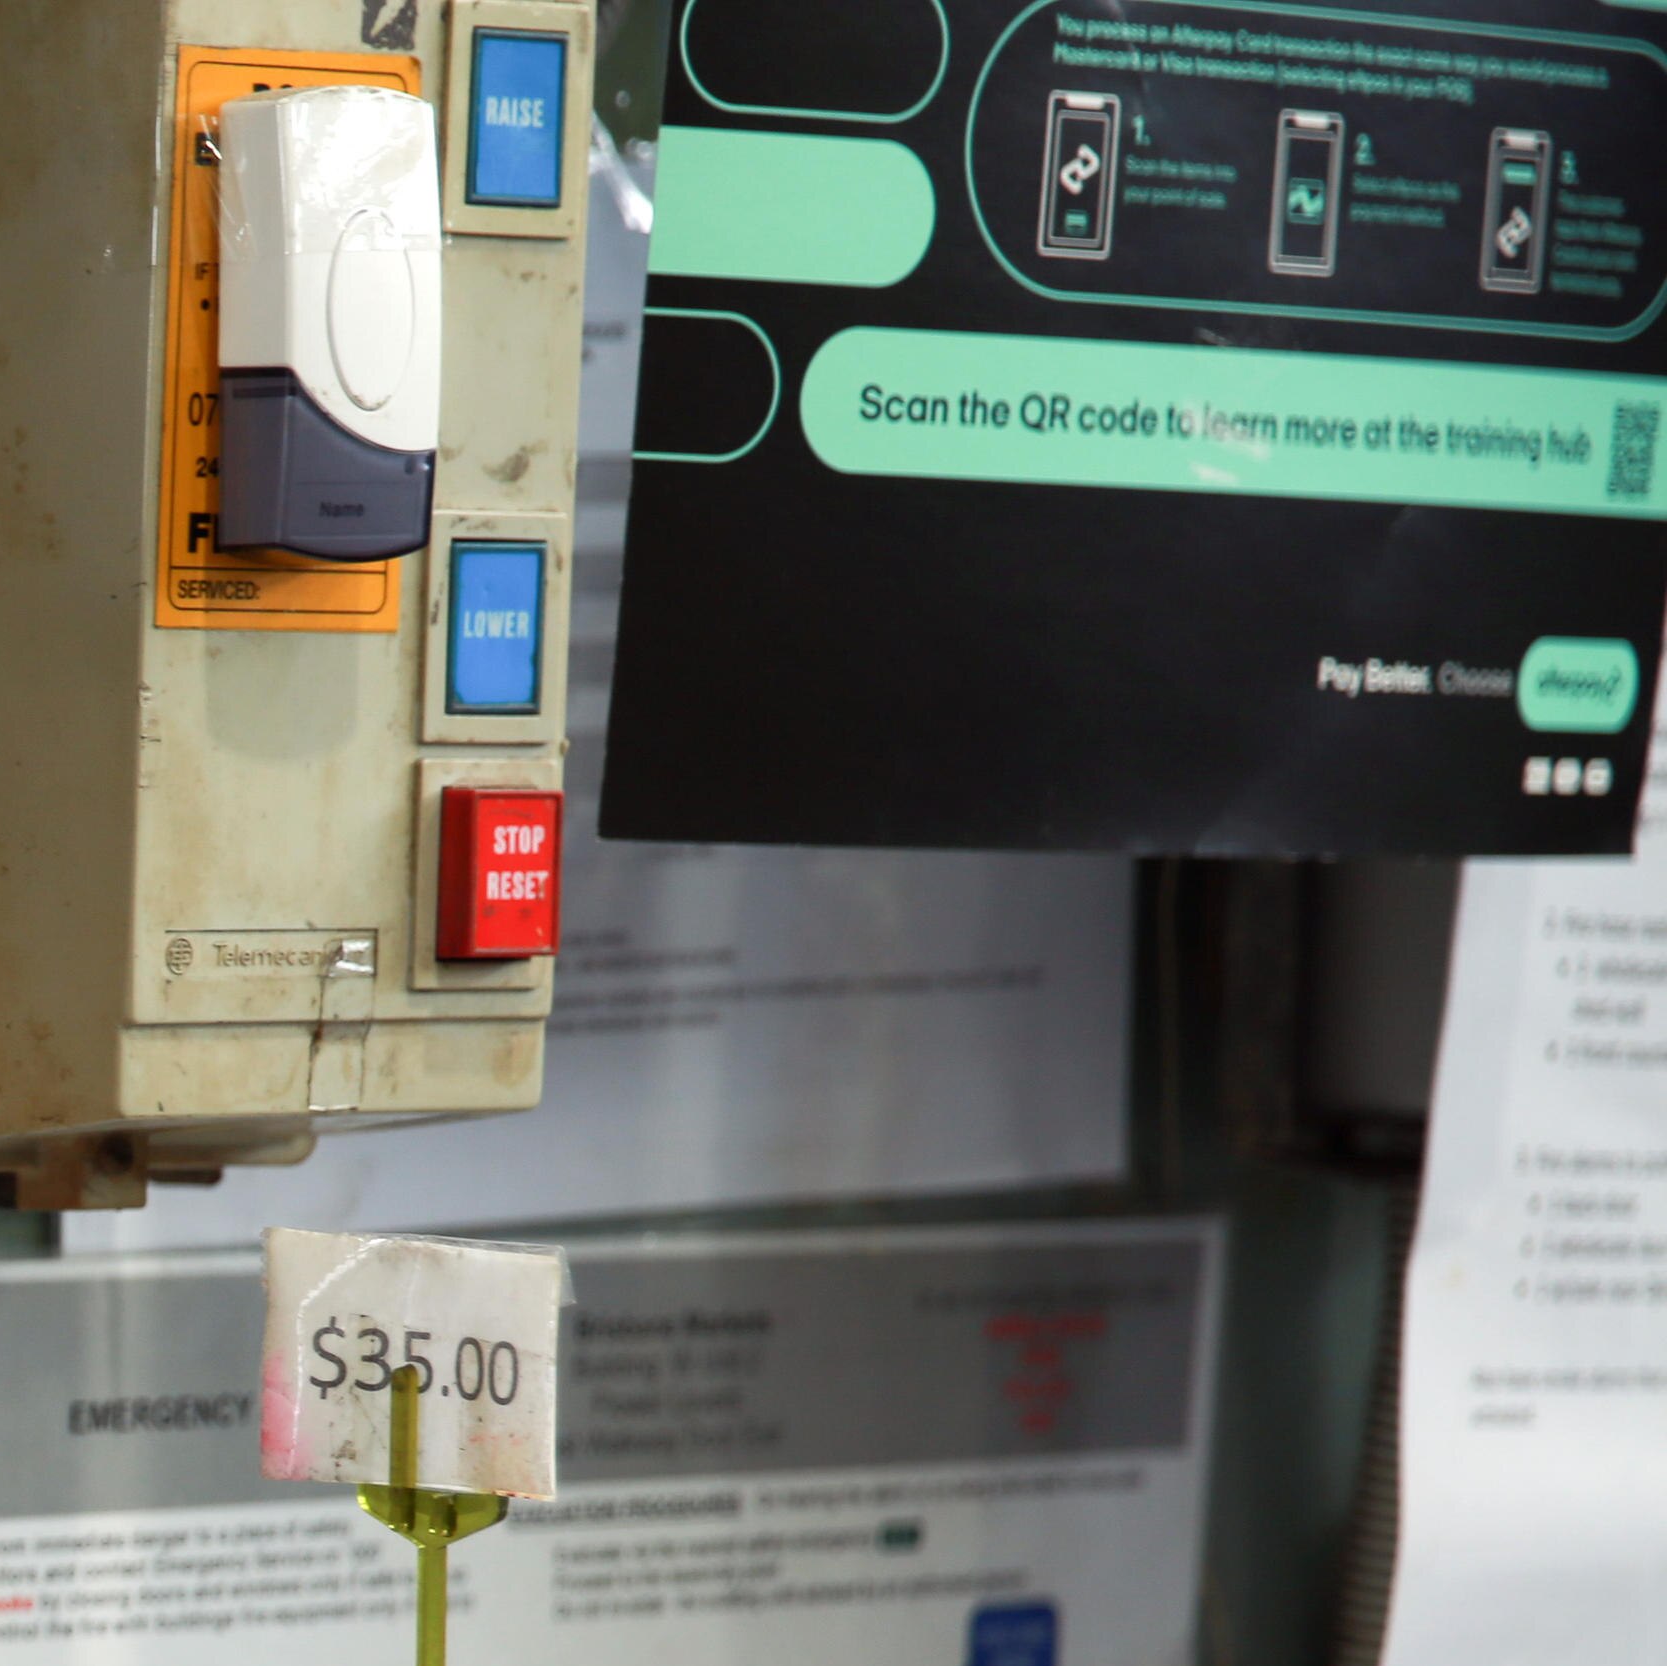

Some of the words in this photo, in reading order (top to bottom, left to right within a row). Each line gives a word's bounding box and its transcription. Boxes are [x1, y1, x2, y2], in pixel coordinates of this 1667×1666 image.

[485, 96, 545, 129] RAISE
[860, 383, 950, 424] Scan
[958, 388, 1012, 429] the
[1020, 393, 1072, 433] QR
[1078, 400, 1159, 437] code
[1167, 407, 1196, 438] to
[1204, 402, 1278, 443] learn
[1283, 413, 1358, 449] more
[1366, 414, 1393, 450] at
[1398, 413, 1440, 454] the
[1447, 415, 1543, 470] training
[1546, 421, 1593, 466] hub
[319, 502, 365, 518] Name
[177, 579, 262, 602] SERVICED:
[463, 610, 530, 640] LOWER
[1317, 655, 1364, 699] Pay
[493, 825, 546, 855] STOP
[486, 870, 550, 901] RESET
[309, 1316, 520, 1406] $35.00
[68, 1389, 253, 1437] EMERGENCY
